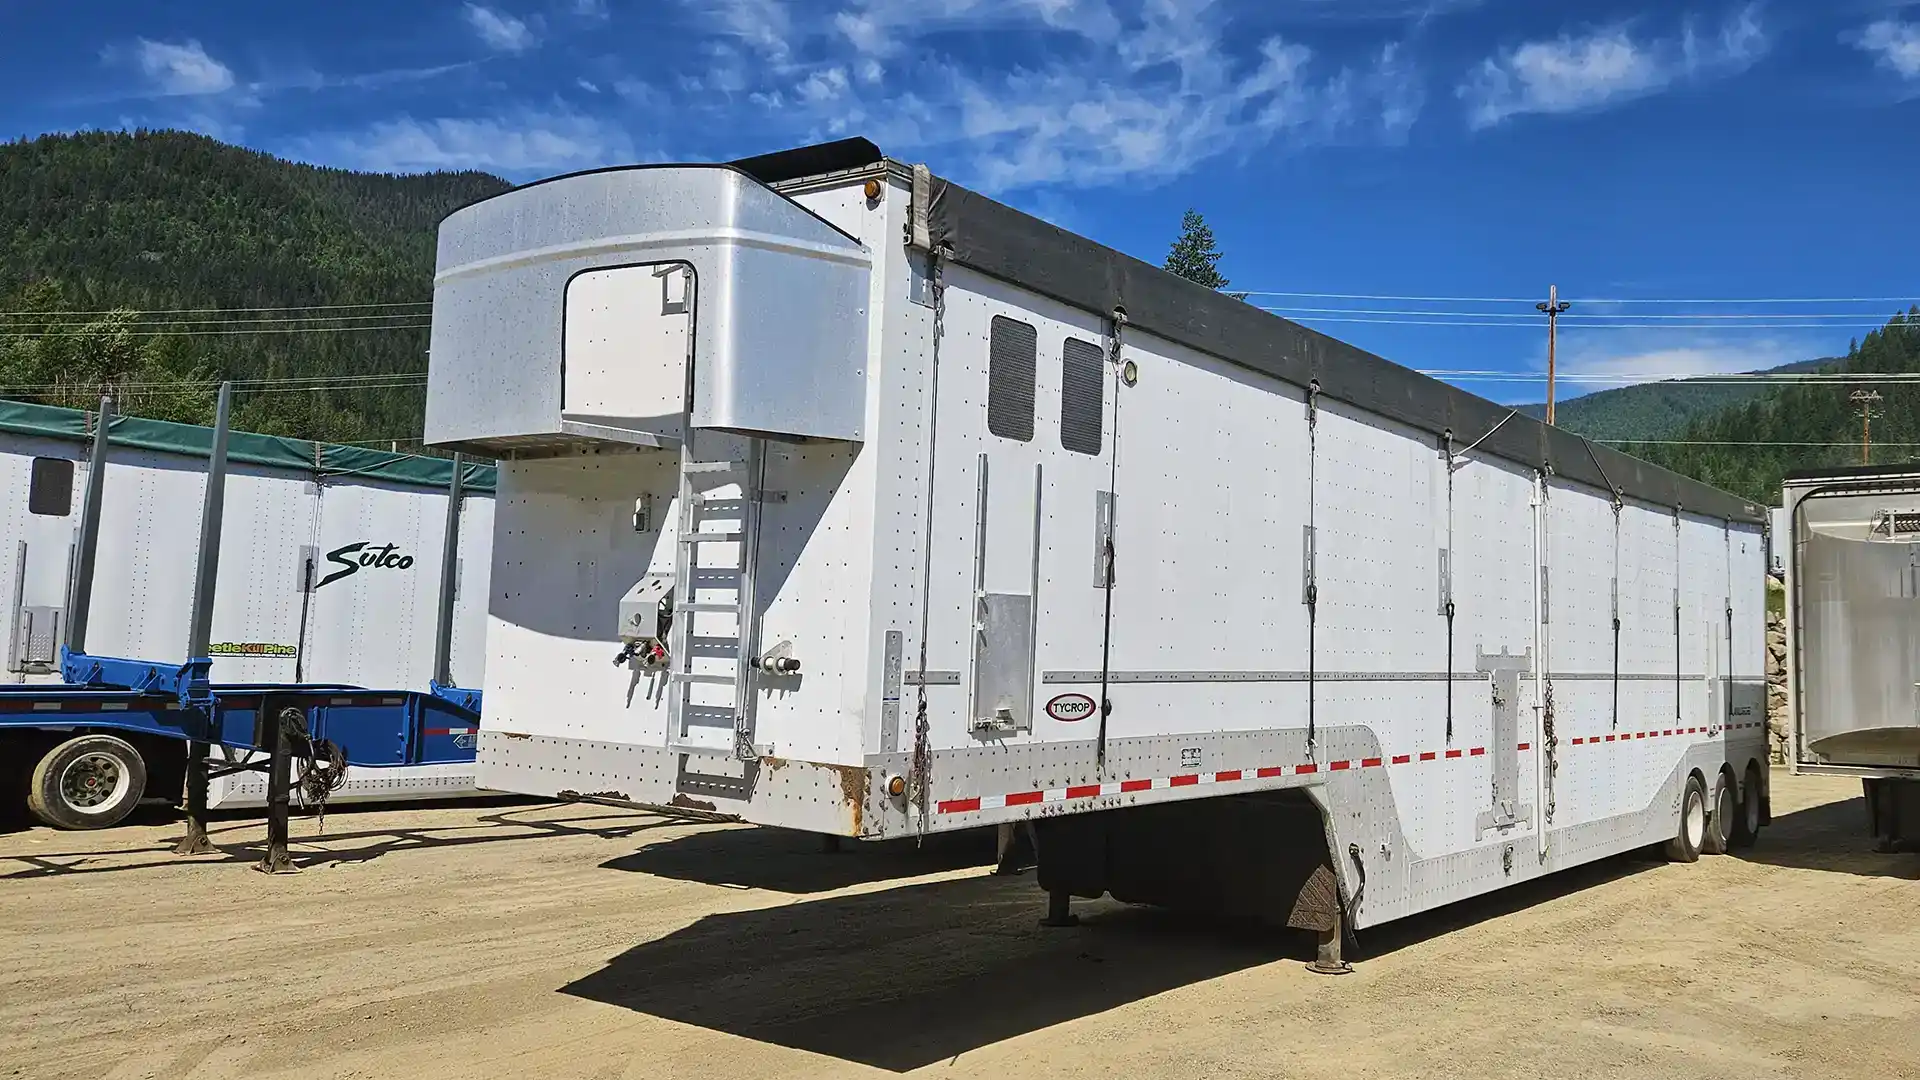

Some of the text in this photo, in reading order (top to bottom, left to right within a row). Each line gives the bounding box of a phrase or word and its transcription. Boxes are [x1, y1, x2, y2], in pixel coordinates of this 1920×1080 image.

[314, 541, 414, 589] Sutco
[208, 642, 296, 655] etleKillPine
[1053, 702, 1090, 713] TYCROP
